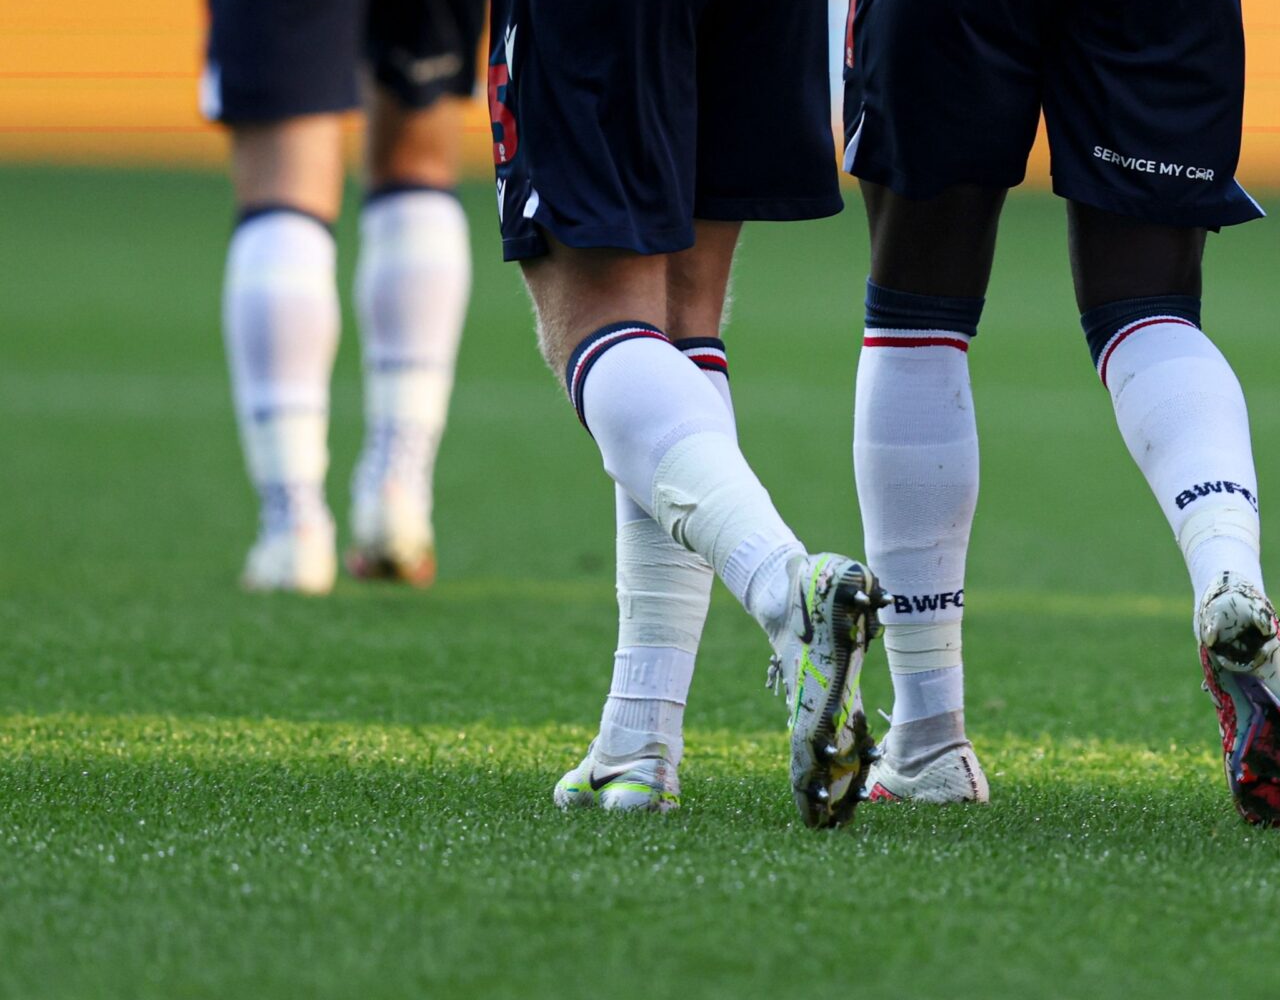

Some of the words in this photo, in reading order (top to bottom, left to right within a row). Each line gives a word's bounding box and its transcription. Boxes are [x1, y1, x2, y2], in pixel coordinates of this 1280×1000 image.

[1093, 145, 1156, 173] SERVICE
[1159, 162, 1184, 177] MY
[1175, 480, 1258, 512] BWFC
[893, 589, 965, 614] BWFC
